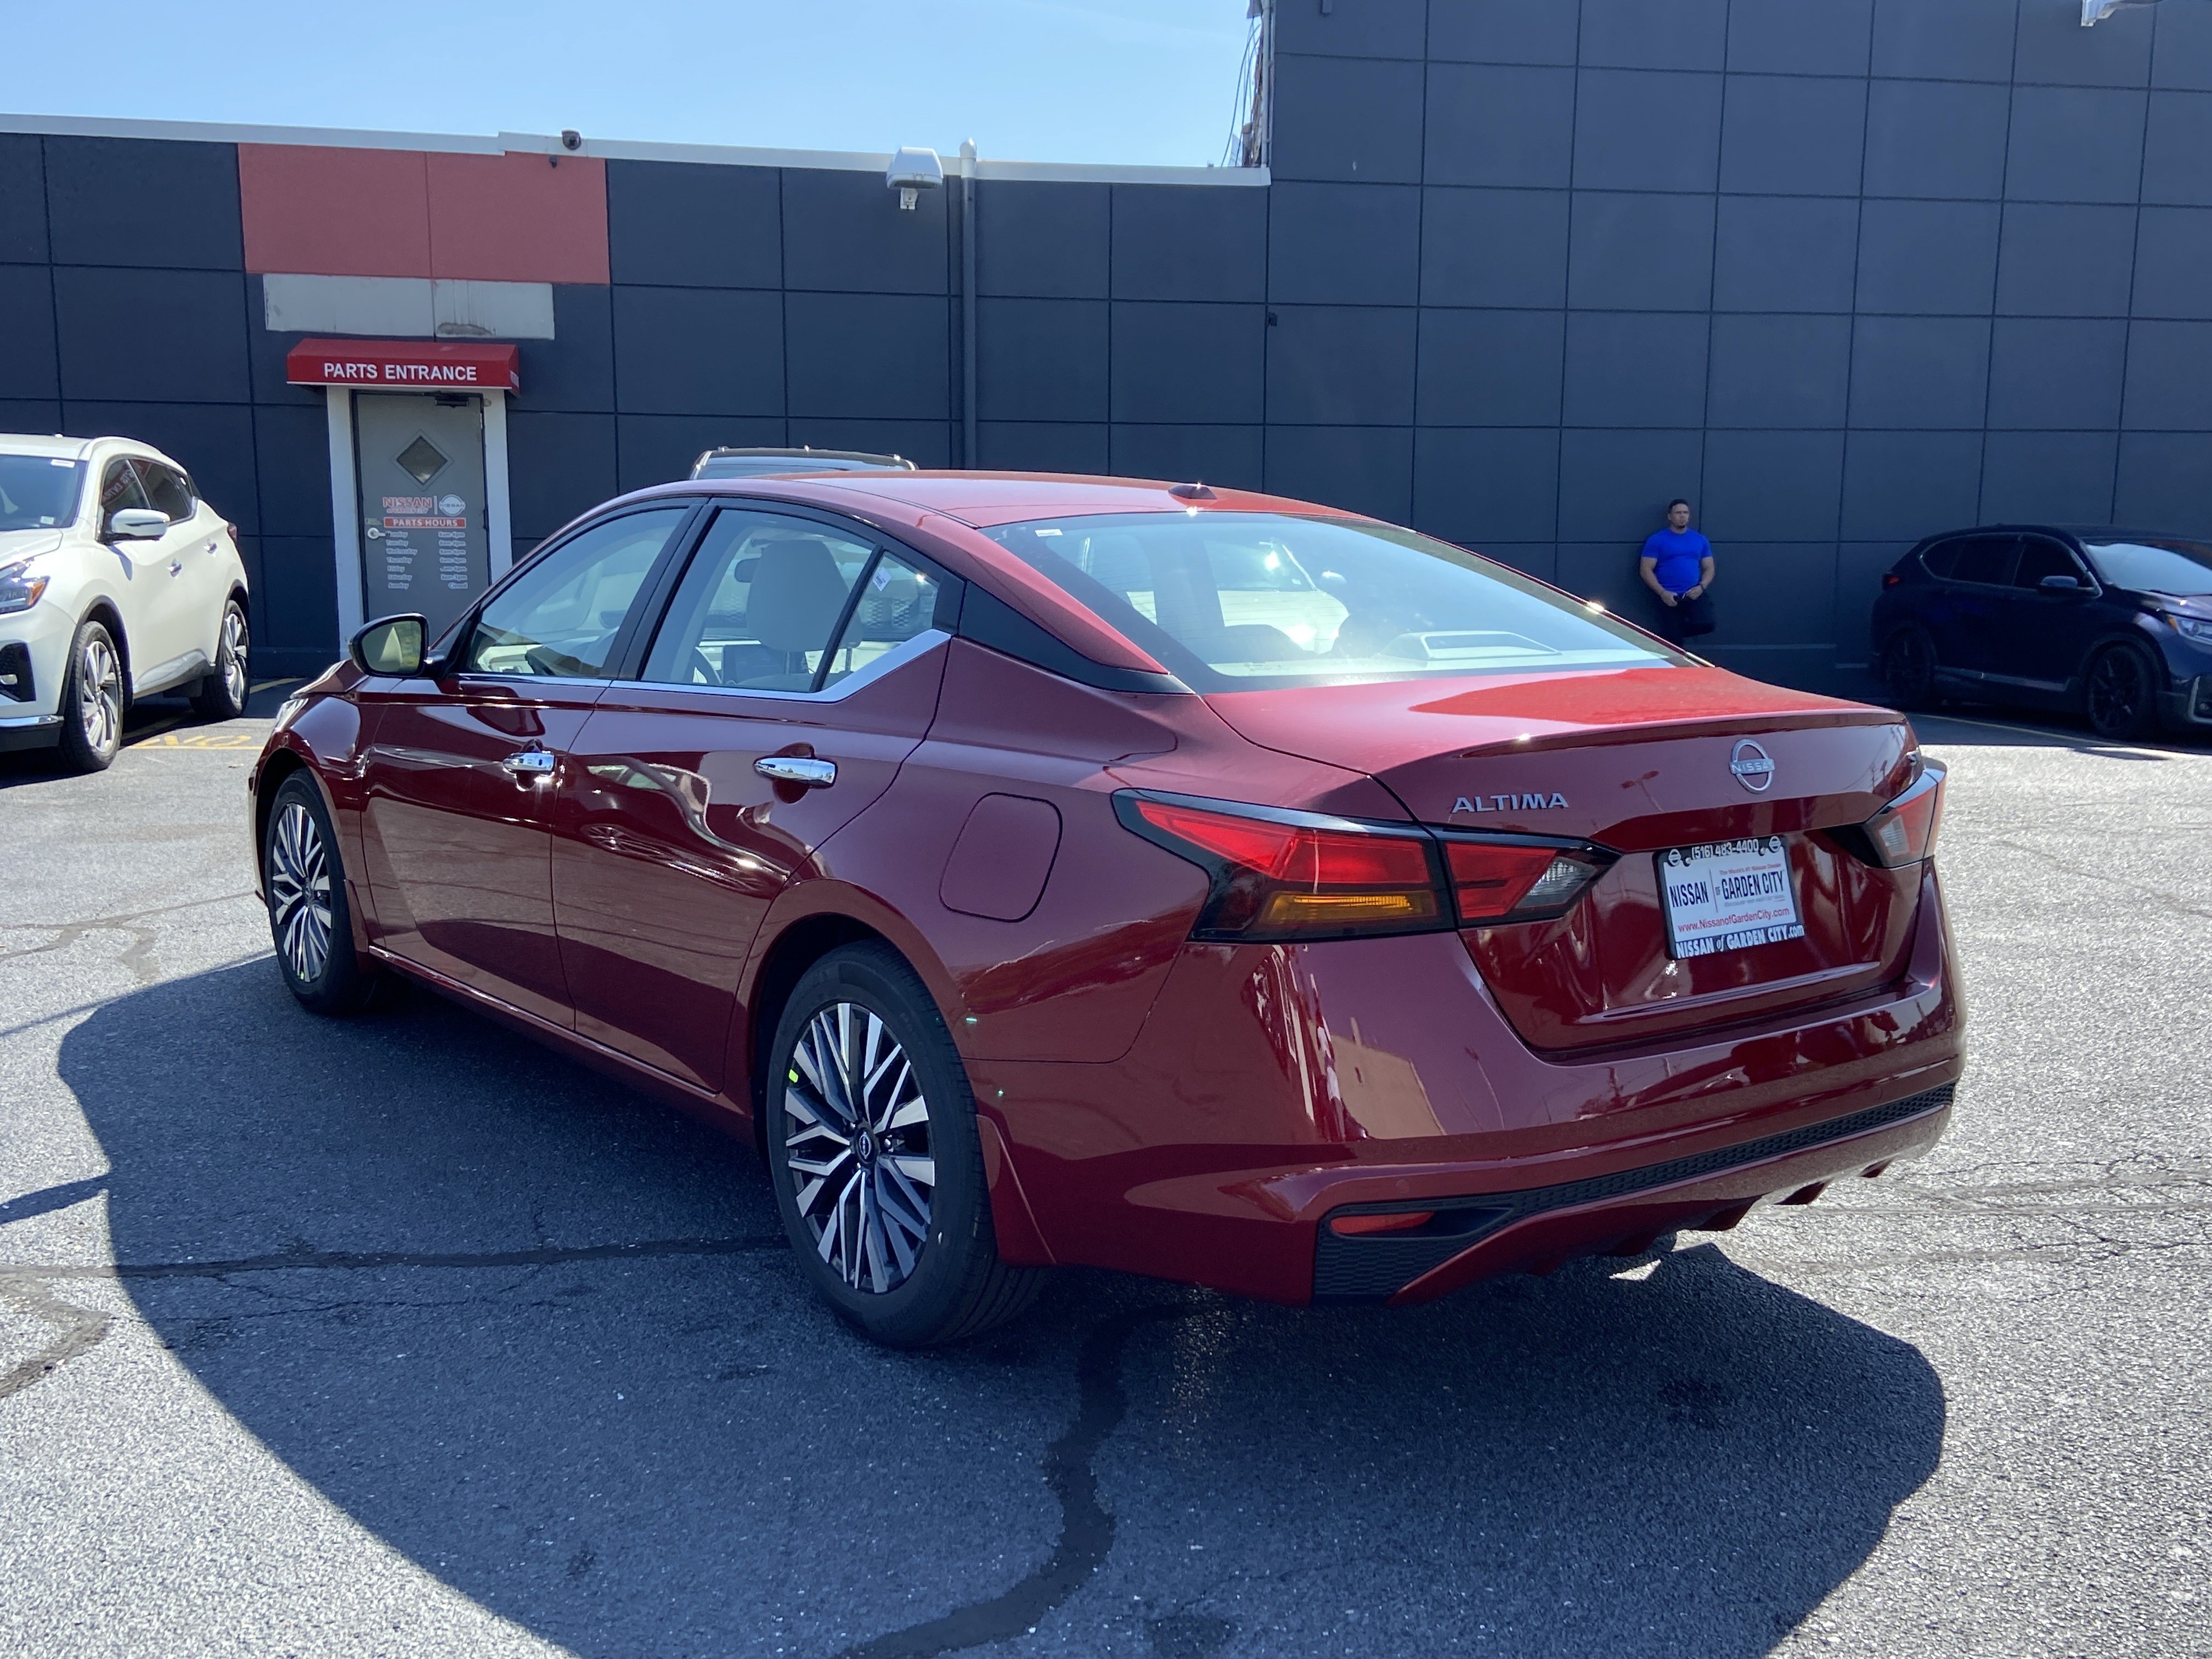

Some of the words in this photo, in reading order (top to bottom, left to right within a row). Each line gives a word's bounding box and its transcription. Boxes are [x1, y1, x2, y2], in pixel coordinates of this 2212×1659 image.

[324, 363, 378, 379] PARTS
[385, 364, 477, 381] ENTRANCE
[383, 496, 432, 509] NISSAN
[1731, 760, 1775, 772] NISSAN
[1452, 793, 1570, 813] ALTIMA
[1691, 845, 1713, 860] (516)
[1715, 839, 1759, 856] 483-4400
[1669, 881, 1709, 907] NISSAN
[1722, 873, 1762, 900] GARDEN
[1762, 871, 1784, 894] CITY
[1678, 908, 1790, 933] www.NissanofGardenCity.com
[1675, 937, 1715, 958] NISSAN
[1716, 935, 1725, 952] of
[1726, 929, 1767, 950] GARDEN
[1768, 924, 1805, 943] CITY.com
